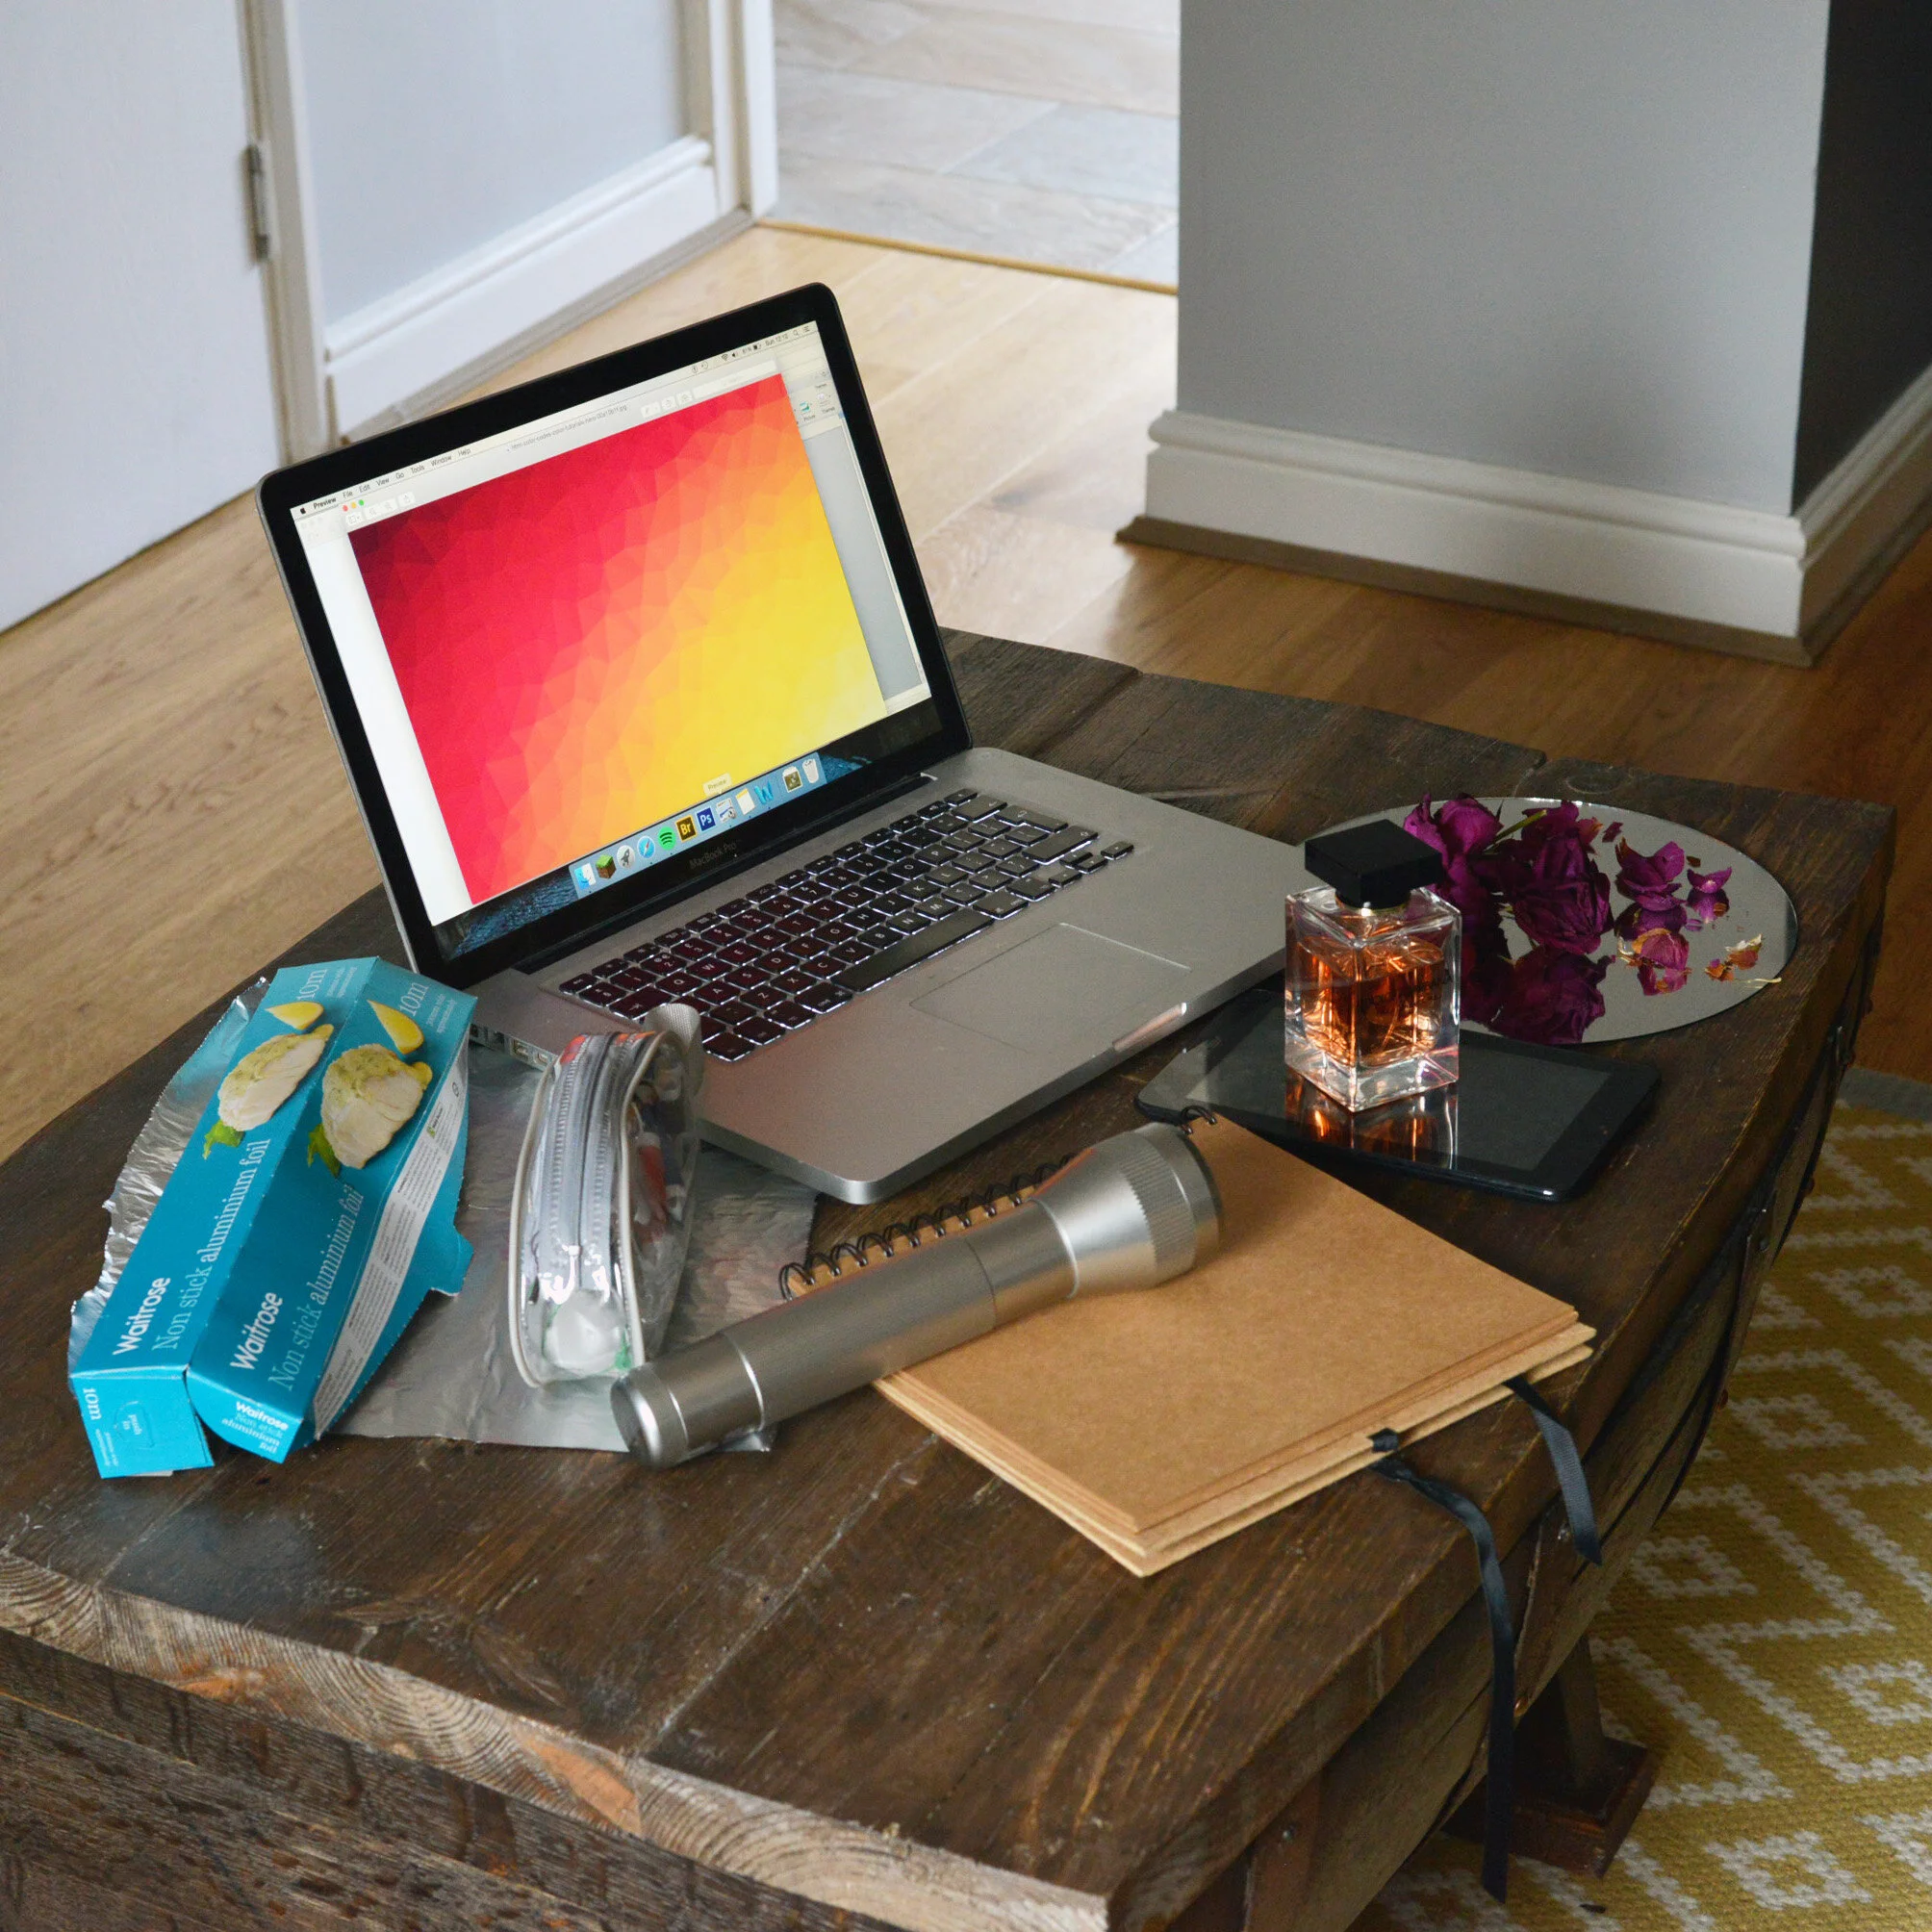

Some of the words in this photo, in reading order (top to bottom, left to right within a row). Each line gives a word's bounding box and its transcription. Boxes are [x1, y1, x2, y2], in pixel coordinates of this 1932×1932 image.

[313, 497, 337, 510] Preview
[343, 490, 353, 498] File
[359, 483, 370, 493] Edit
[376, 477, 390, 487] View
[395, 471, 405, 480] Go
[411, 465, 425, 474] Tools
[430, 455, 452, 467] Window
[458, 447, 471, 457] Help
[679, 823, 691, 835] Br
[700, 814, 712, 826] Ps
[690, 847, 722, 869] MacBook
[723, 842, 737, 853] Pro
[296, 968, 328, 1000] 10m
[398, 982, 430, 1017] 10m
[151, 1311, 191, 1351] Non
[179, 1265, 213, 1308] stick
[196, 1167, 258, 1262] aluminium
[239, 1139, 271, 1165] foil
[267, 1350, 305, 1391] Non
[290, 1304, 322, 1349] stick
[306, 1214, 356, 1306] aluminium
[338, 1183, 364, 1217] foil
[112, 1277, 171, 1355] Waitrose
[230, 1292, 283, 1370] Waitrose
[83, 1387, 102, 1420] 10m
[236, 1401, 289, 1431] Waitrose
[122, 1419, 131, 1431] in
[127, 1414, 142, 1435] push
[221, 1417, 280, 1446] aluminium
[235, 1411, 257, 1429] Non
[259, 1441, 278, 1454] foil
